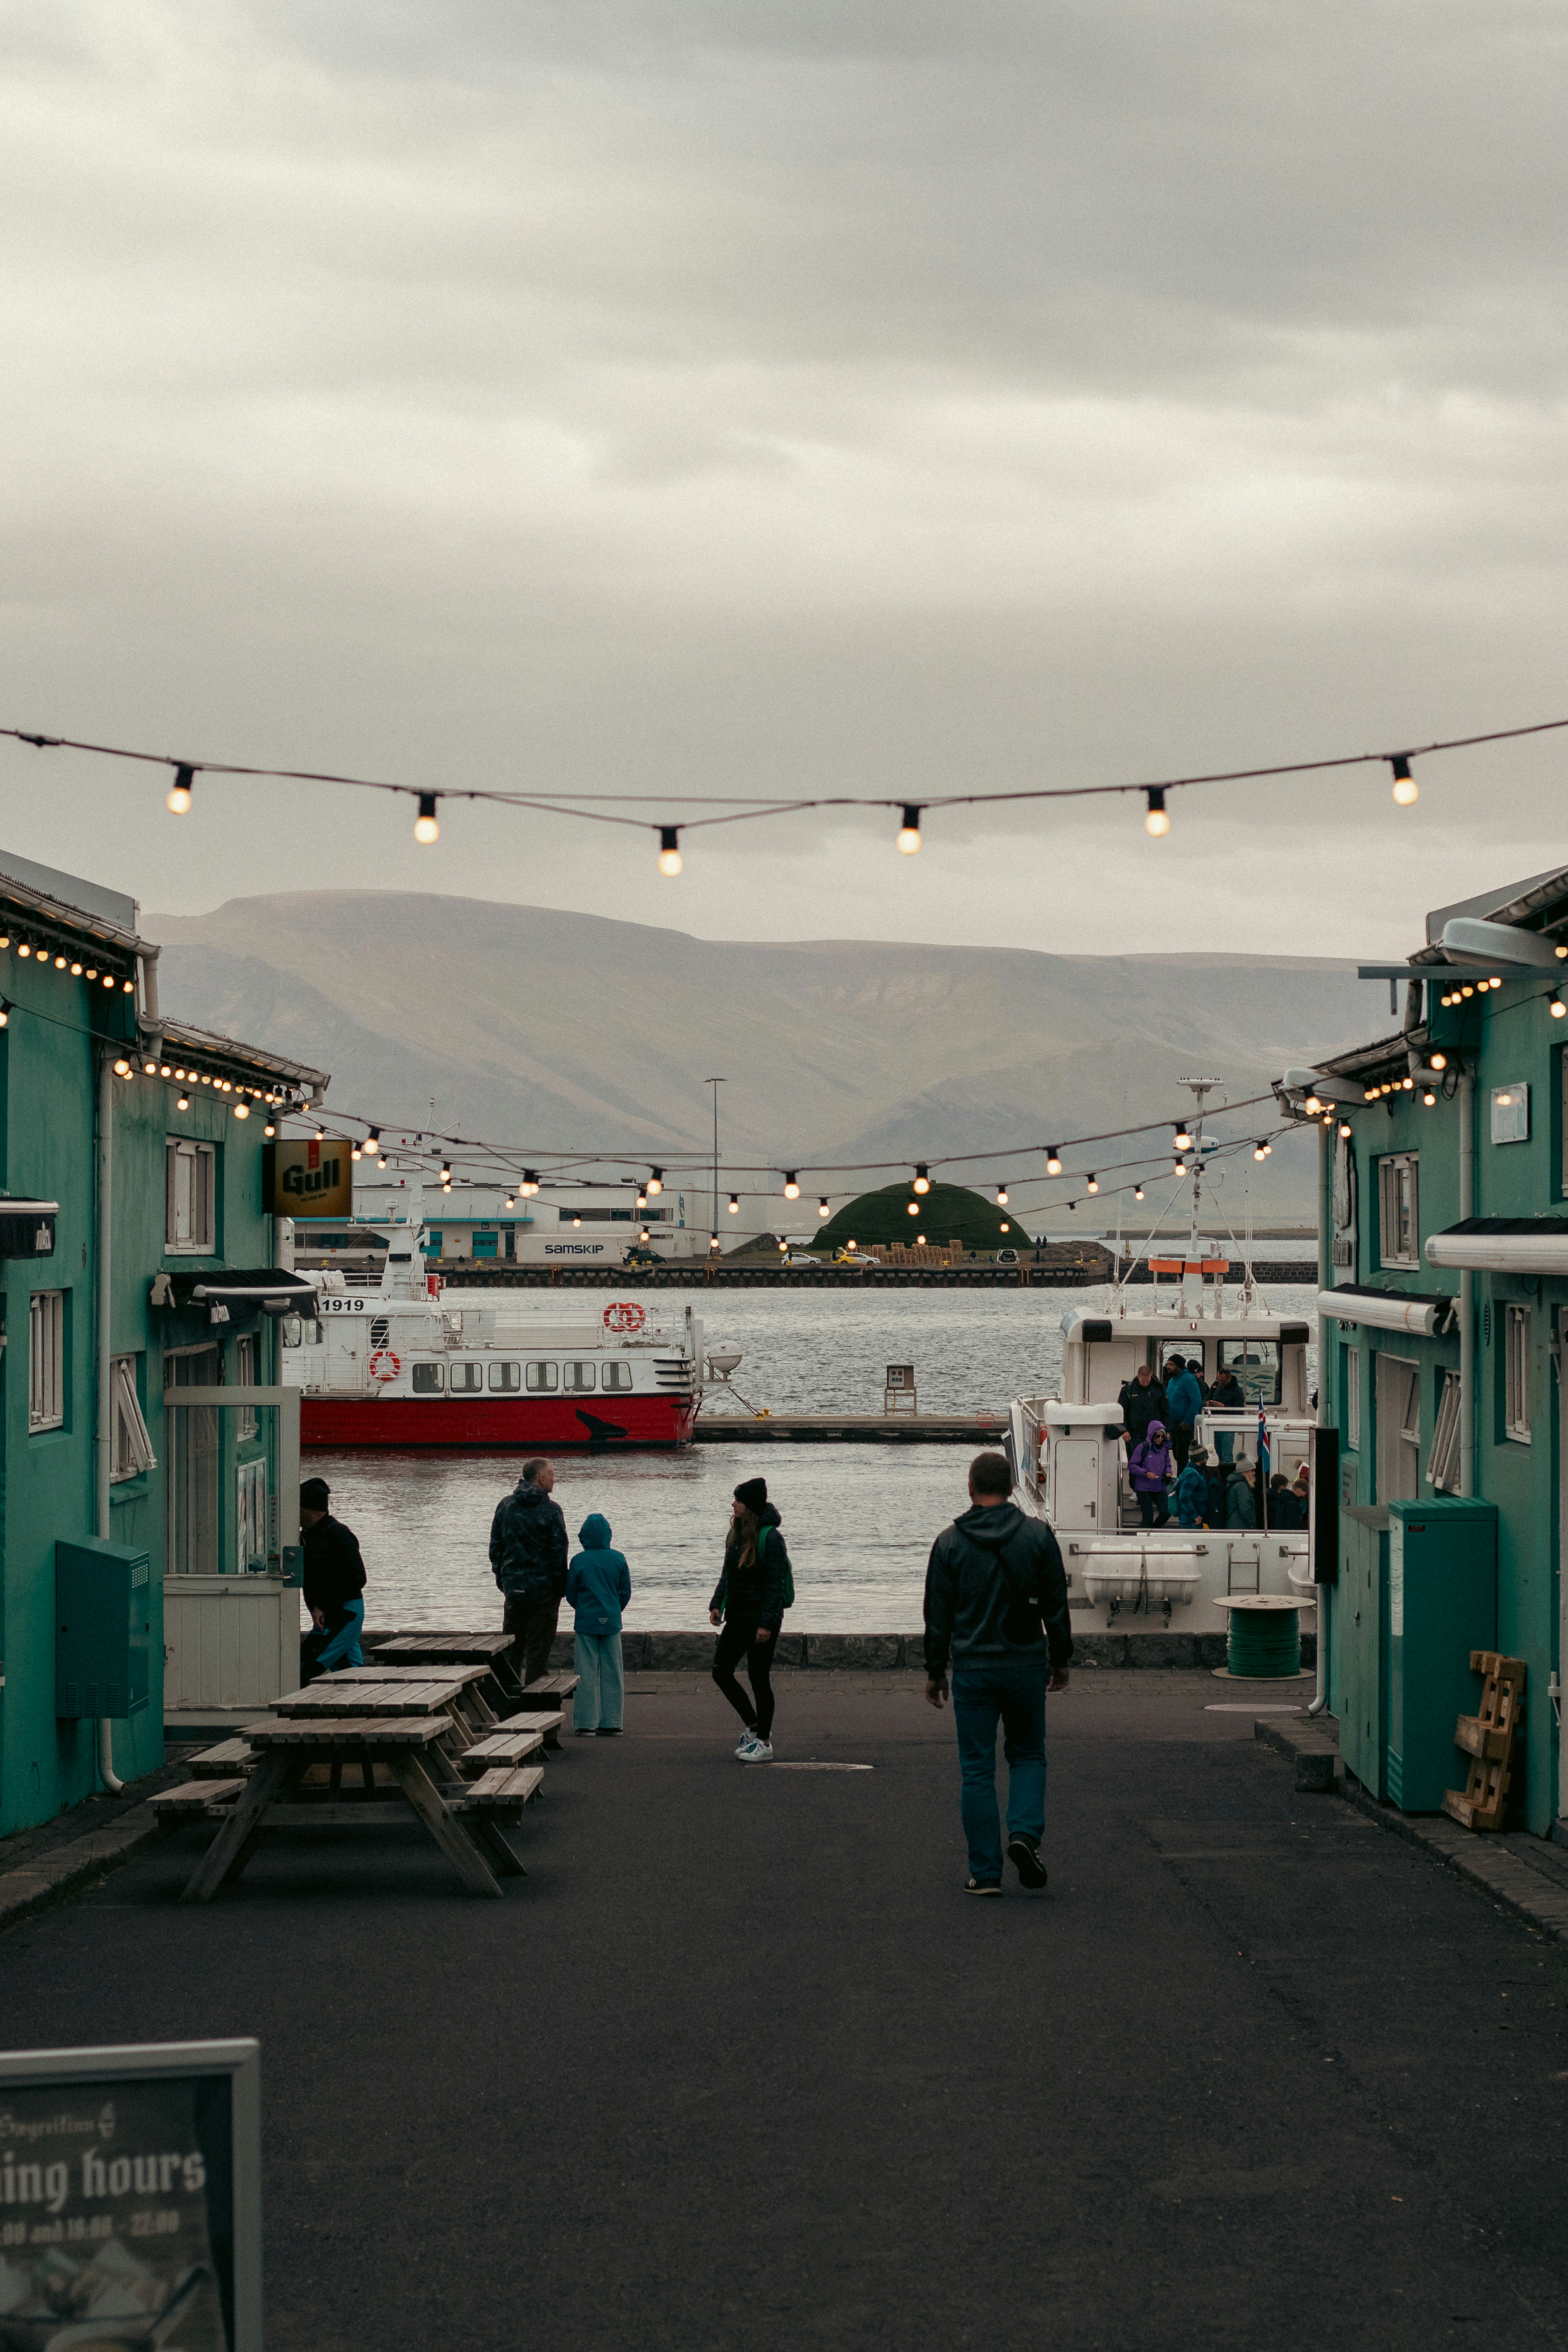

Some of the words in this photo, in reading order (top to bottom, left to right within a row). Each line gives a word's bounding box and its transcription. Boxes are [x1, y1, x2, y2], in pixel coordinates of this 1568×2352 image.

[283, 1158, 340, 1196] Gull
[322, 1299, 364, 1311] 1919
[82, 2146, 206, 2199] hours
